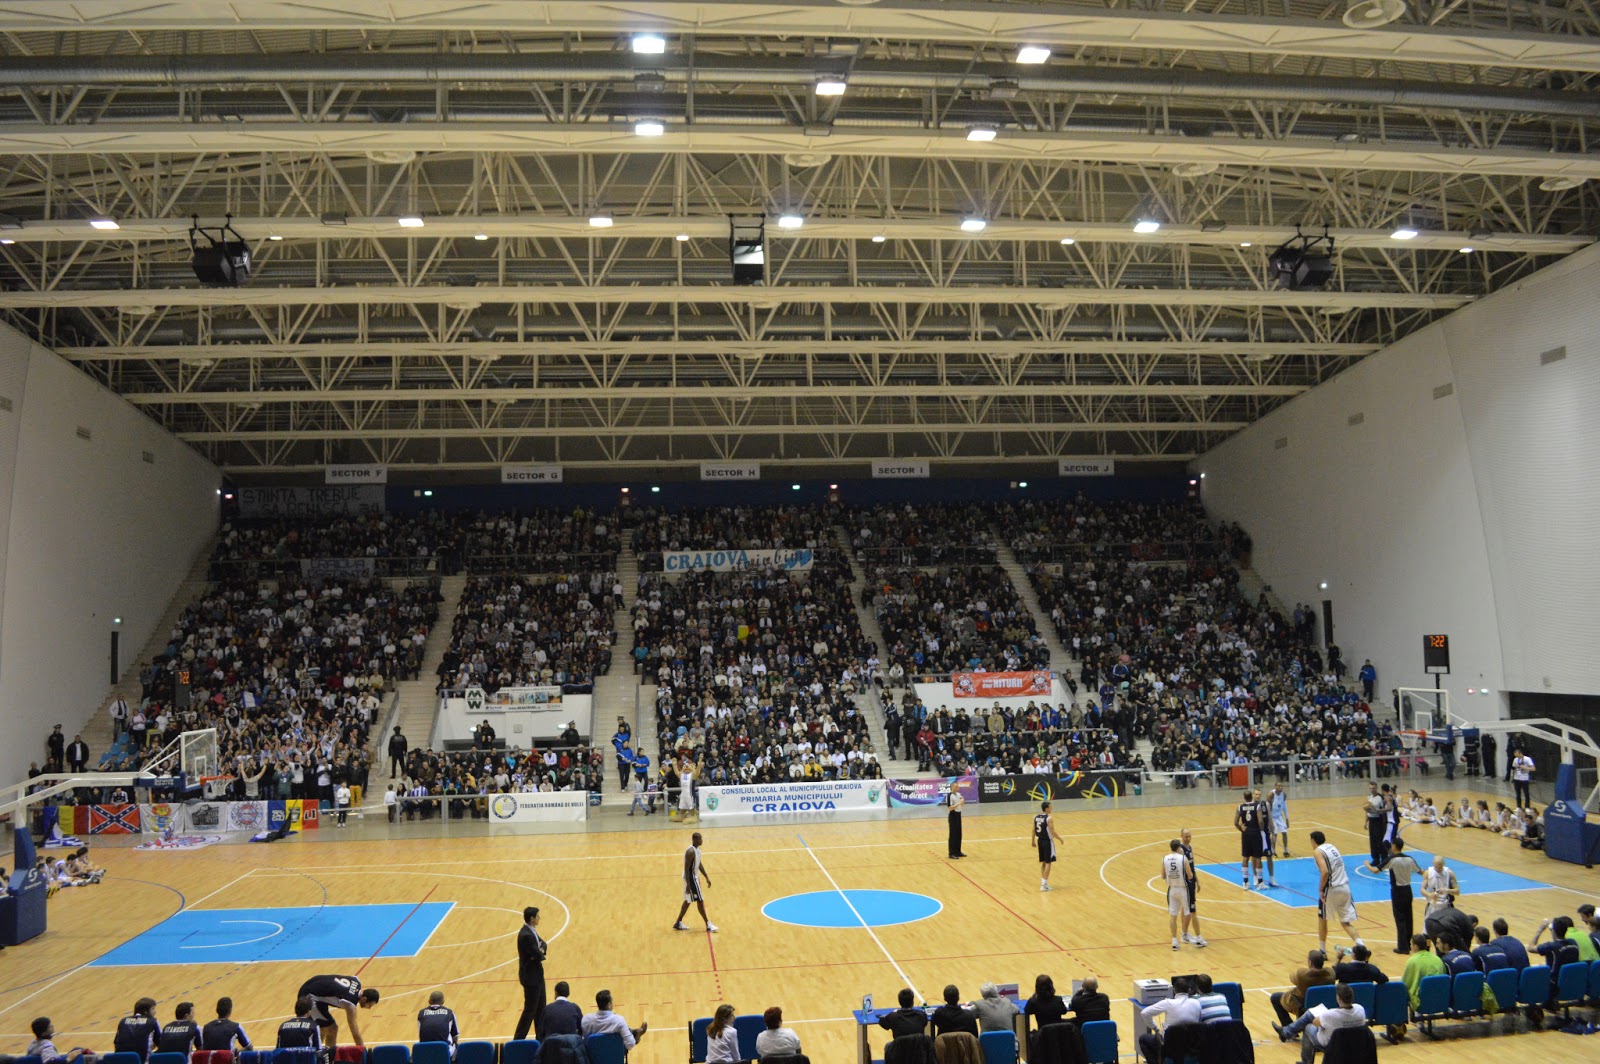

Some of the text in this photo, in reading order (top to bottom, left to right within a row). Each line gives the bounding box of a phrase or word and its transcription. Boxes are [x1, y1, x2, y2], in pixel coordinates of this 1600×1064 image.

[666, 548, 750, 570] CRAIOVA
[1429, 635, 1445, 648] 7:22
[722, 788, 755, 797] CONSILIUL
[757, 786, 777, 794] LOCAL
[789, 784, 832, 793] MUNICIPIULUI
[835, 783, 862, 791] CRAIOVA
[894, 783, 933, 792] Actualitatea
[740, 793, 843, 803] PRIMARIA MUNICIPIULUI
[752, 800, 836, 813] CRAIOVA
[1246, 810, 1252, 821] 6
[1036, 822, 1042, 833] 5
[1170, 862, 1177, 870] 5
